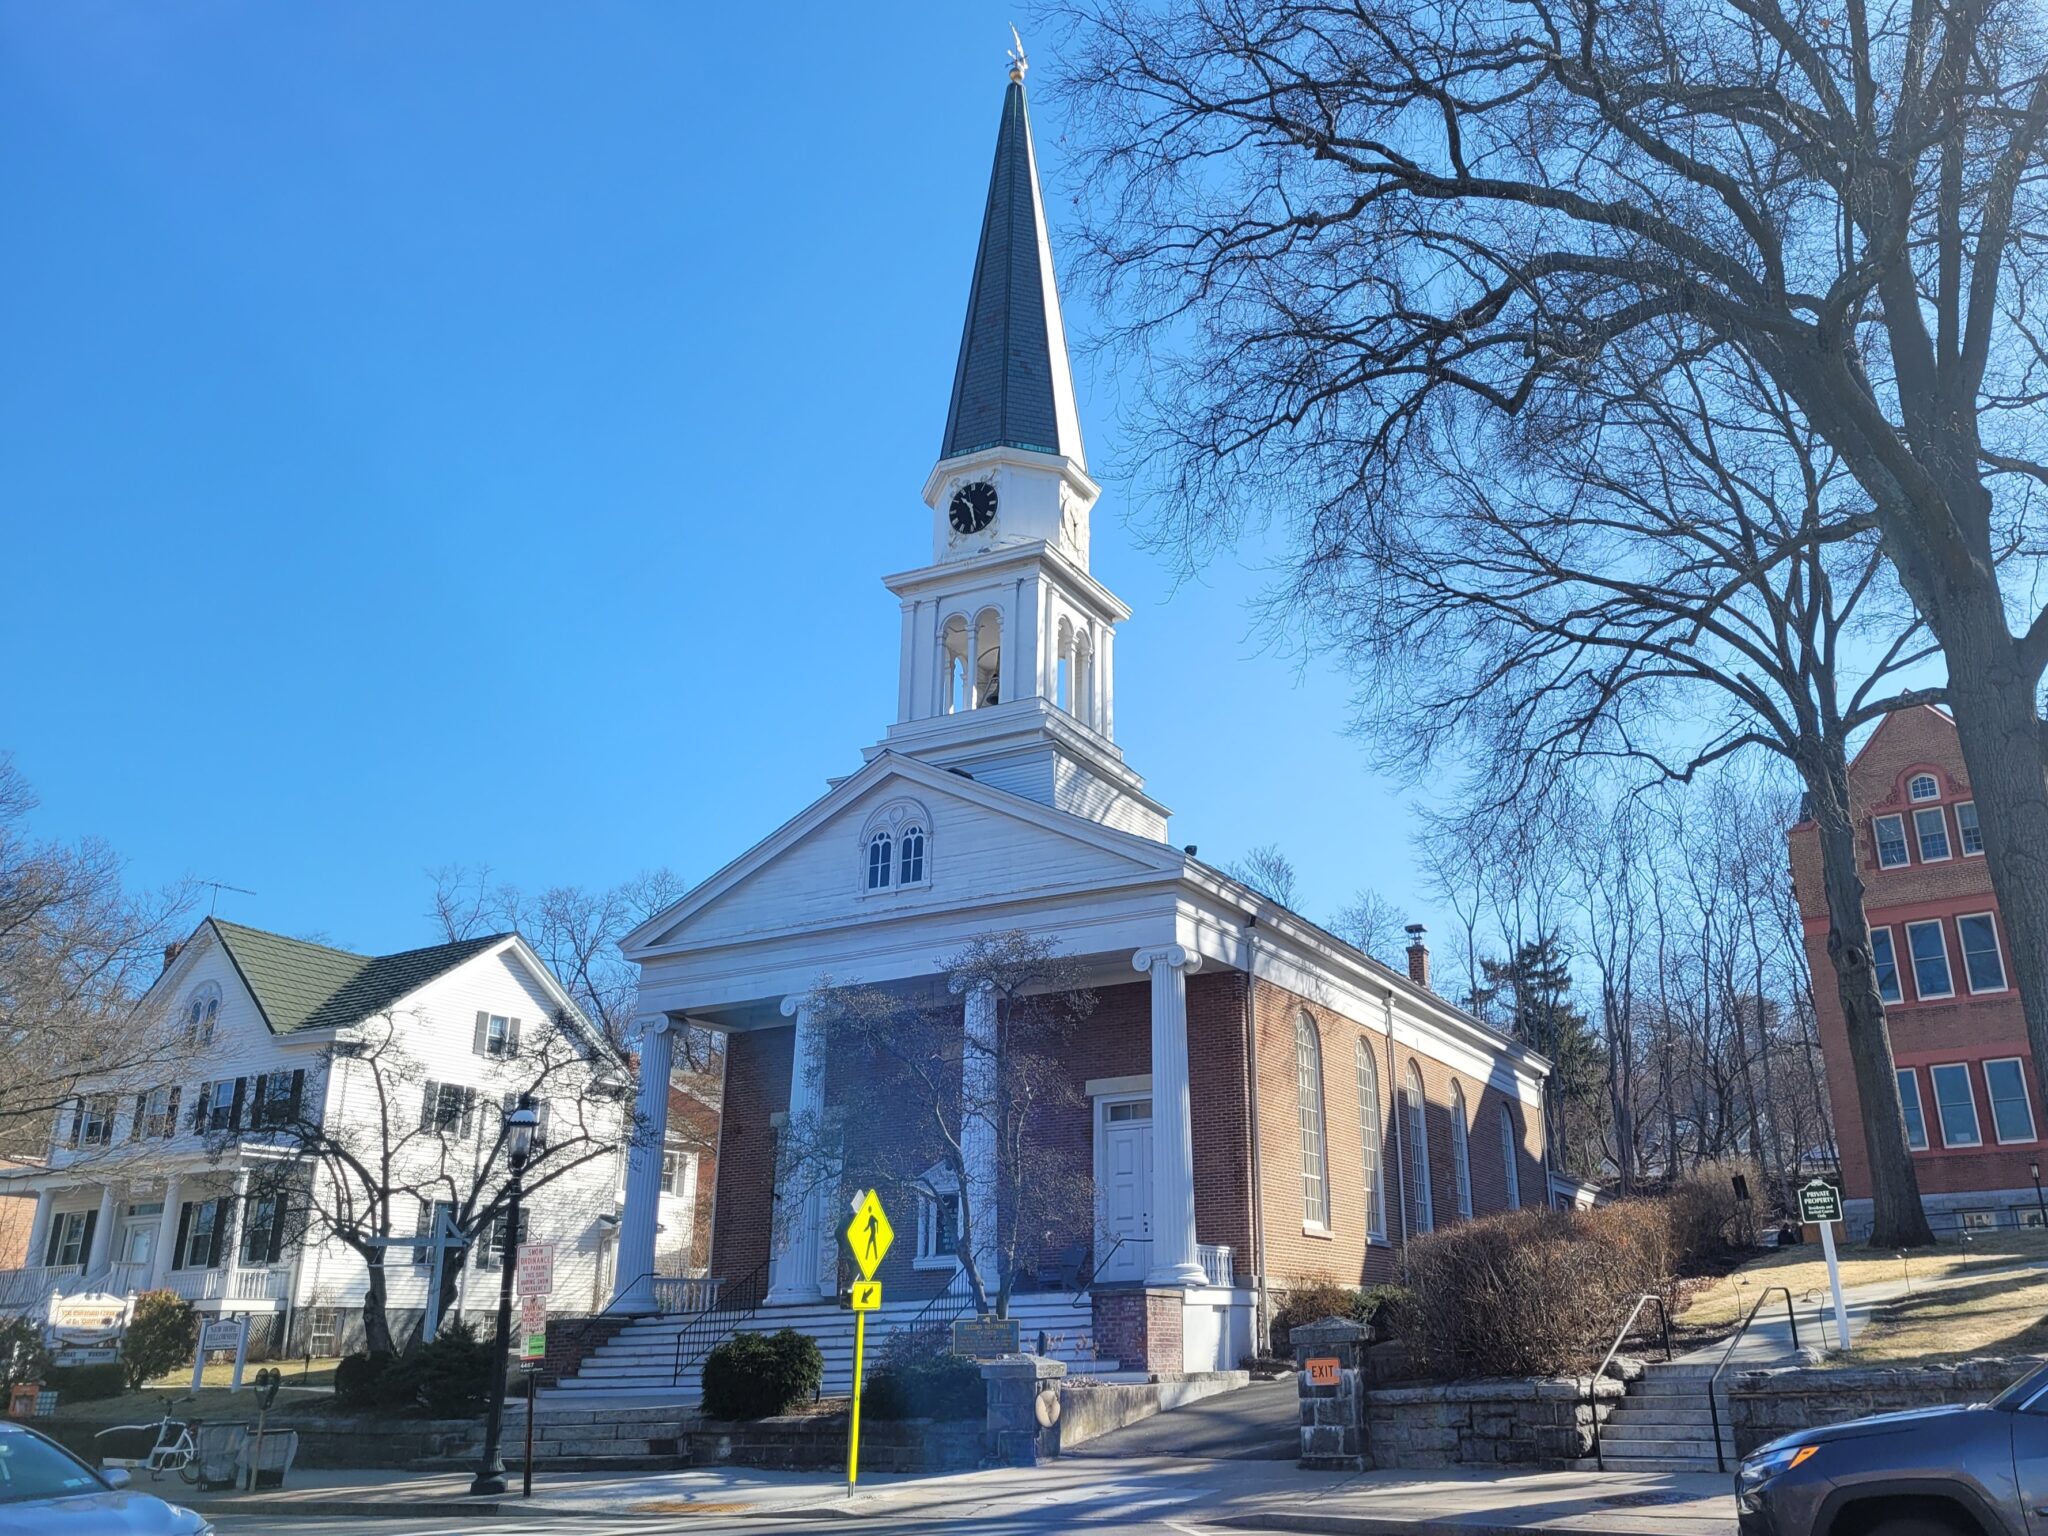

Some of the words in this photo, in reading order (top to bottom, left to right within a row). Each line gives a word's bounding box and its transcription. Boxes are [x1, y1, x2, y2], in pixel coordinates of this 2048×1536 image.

[528, 1248, 543, 1256] SNOW
[521, 1256, 550, 1265] ORDINANCE
[1311, 1365, 1334, 1378] EXIT
